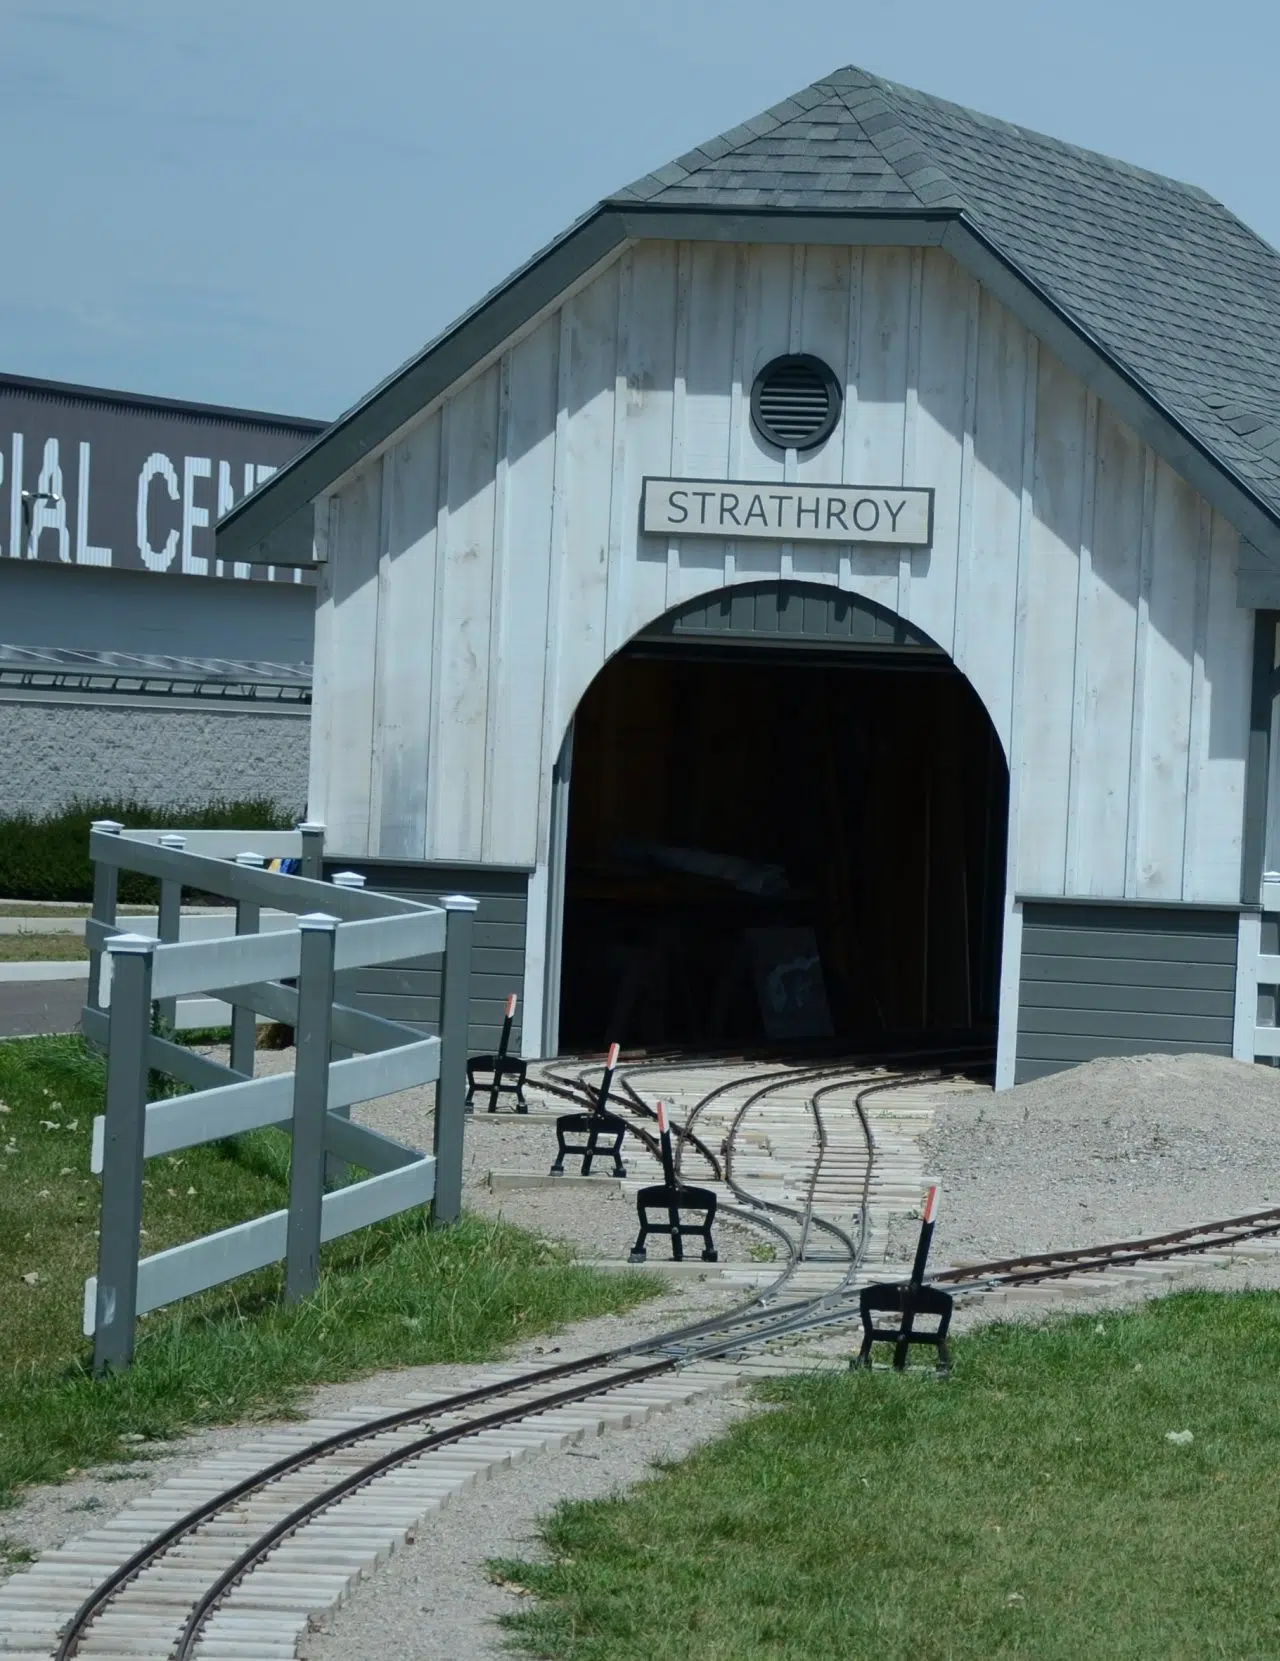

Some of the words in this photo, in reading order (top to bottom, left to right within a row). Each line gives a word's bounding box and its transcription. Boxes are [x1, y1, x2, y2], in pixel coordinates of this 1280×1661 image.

[0, 432, 112, 567] IAL
[137, 453, 302, 584] CEN
[667, 490, 906, 532] STRATHROY
